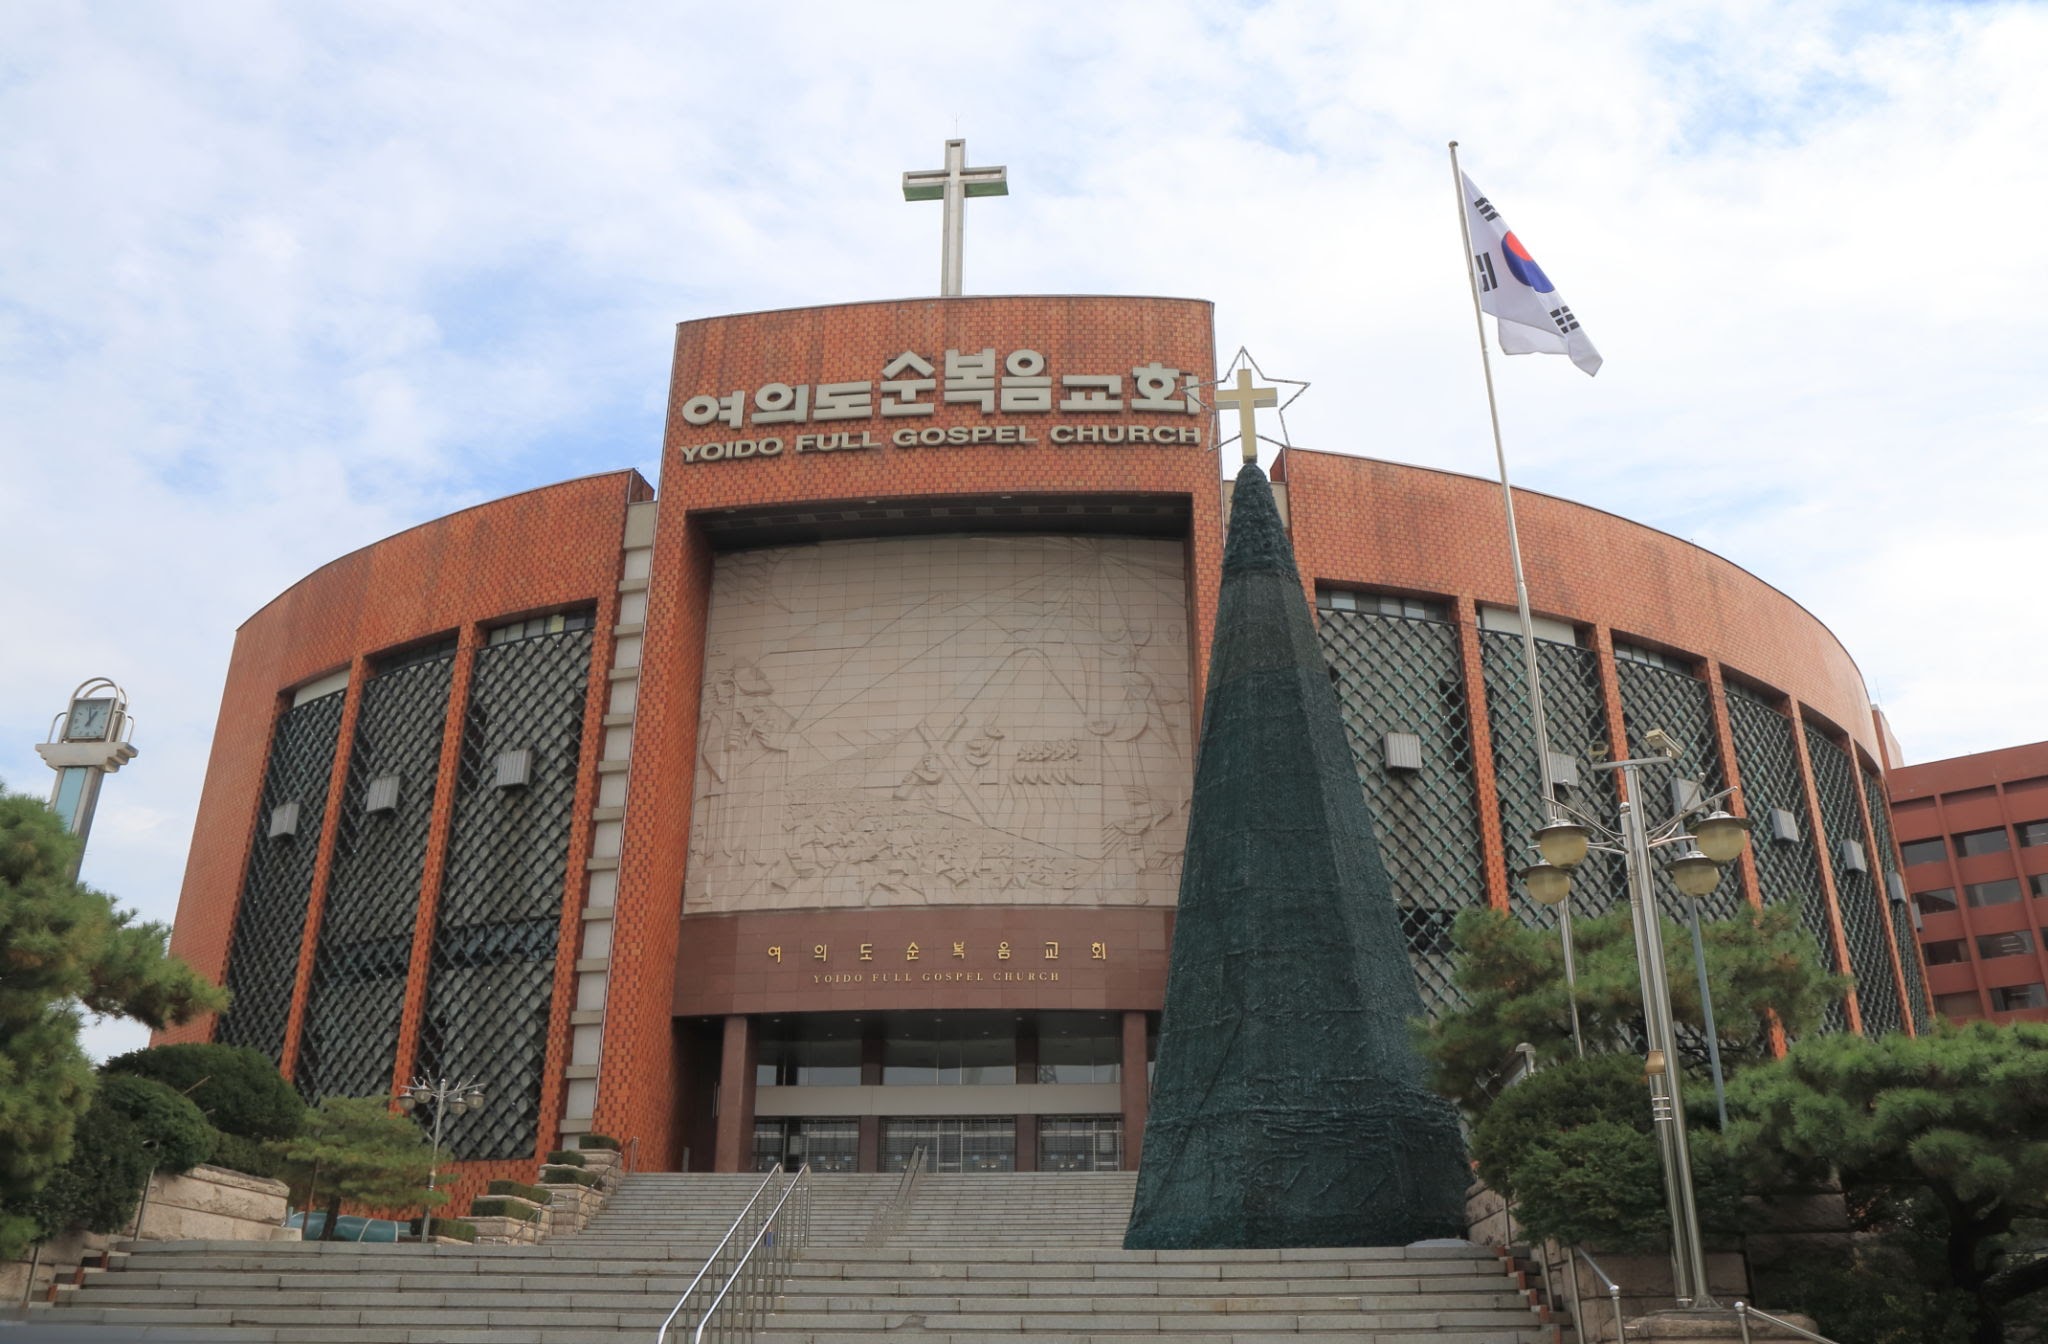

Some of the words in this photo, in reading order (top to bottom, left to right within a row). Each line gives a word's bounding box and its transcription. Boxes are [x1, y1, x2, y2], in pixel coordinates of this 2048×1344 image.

[681, 348, 1200, 427] 여의도순복음교회
[680, 436, 784, 463] YOIDO
[795, 430, 882, 452] FULL
[892, 424, 1039, 448] GOSPEL
[1050, 424, 1201, 445] CHURCH
[813, 973, 864, 984] YOIDO
[872, 972, 913, 983] FULL
[922, 971, 985, 982] GOSPEL
[993, 971, 1060, 982] CHURCH
